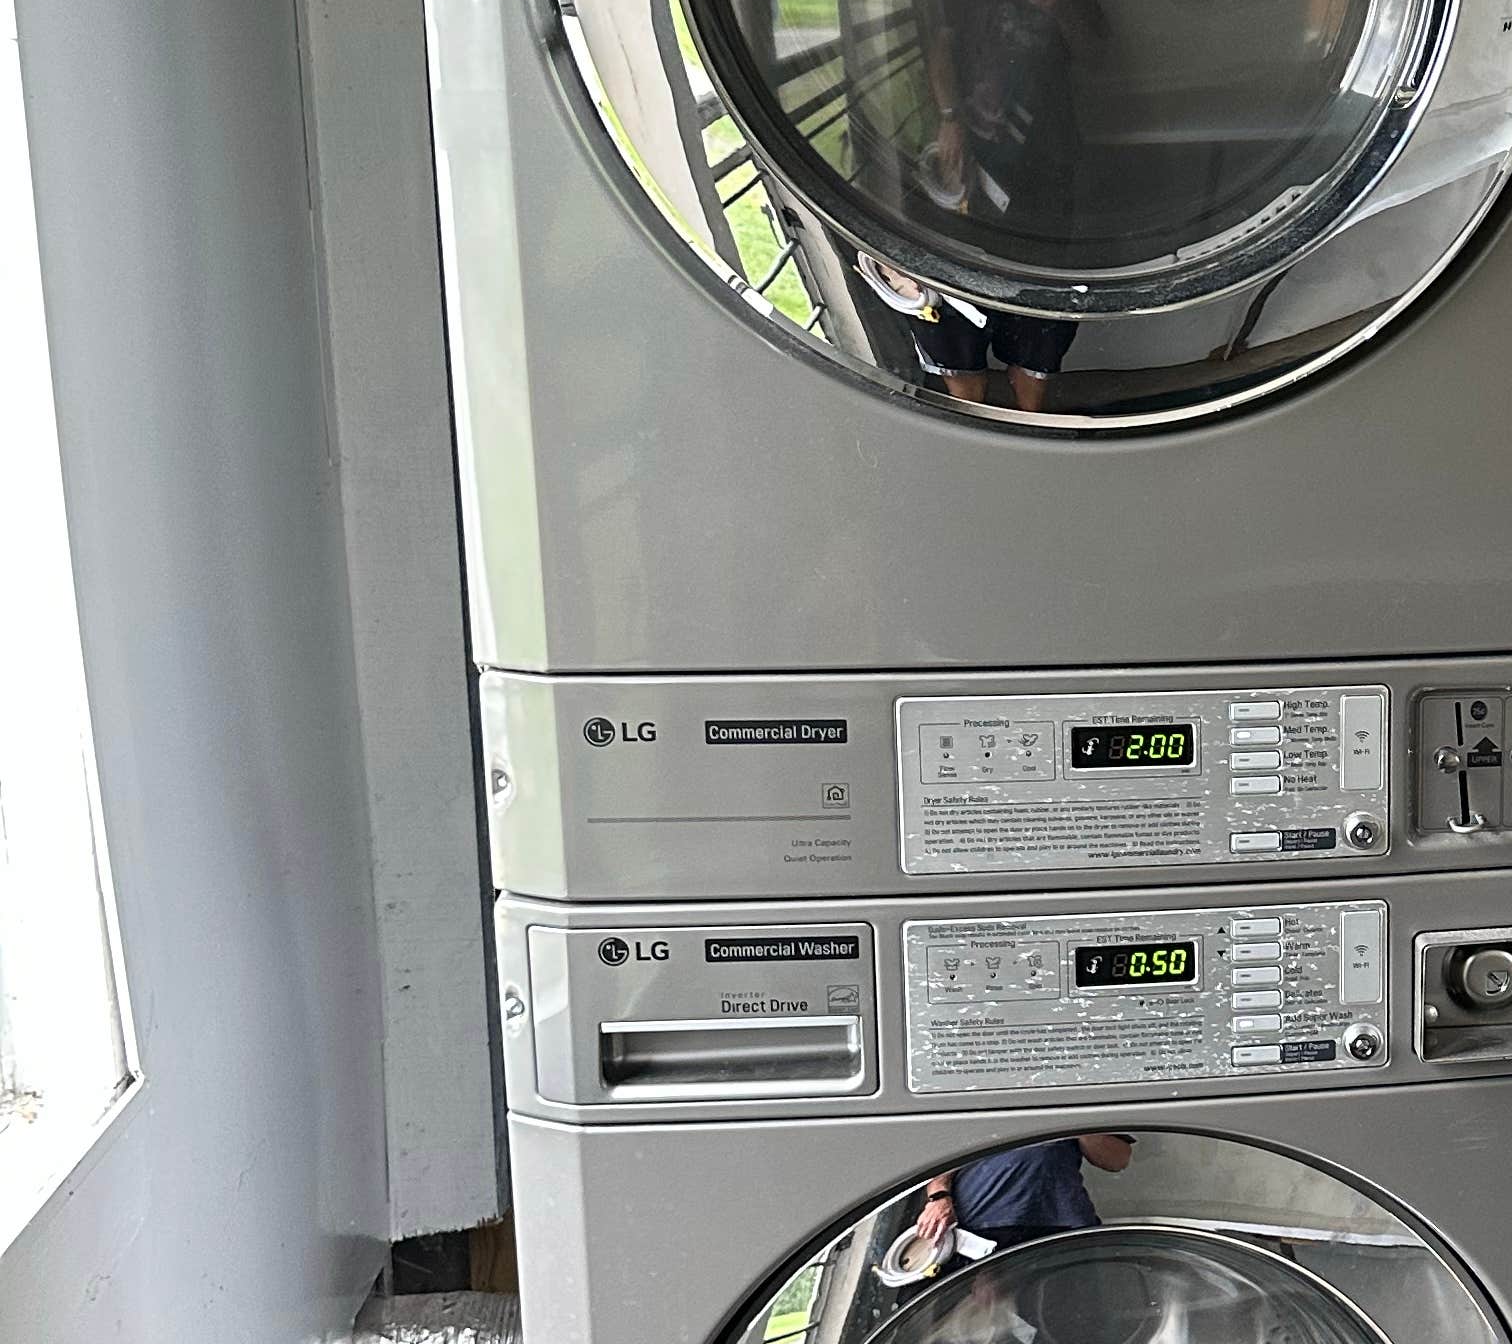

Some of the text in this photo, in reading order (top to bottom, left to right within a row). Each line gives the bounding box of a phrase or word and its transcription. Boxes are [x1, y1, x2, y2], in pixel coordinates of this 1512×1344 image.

[964, 718, 1010, 728] Processing
[1111, 716, 1130, 724] Time
[1131, 715, 1174, 724] Remaining
[621, 722, 657, 742] LG
[709, 725, 844, 741] Commercial Dryer
[814, 838, 852, 848] Capacity
[809, 854, 852, 864] Operation
[710, 941, 855, 958] Commercial Washer
[971, 940, 1016, 949] Processing
[636, 941, 670, 961] LG
[721, 999, 809, 1013] Direct Drive
